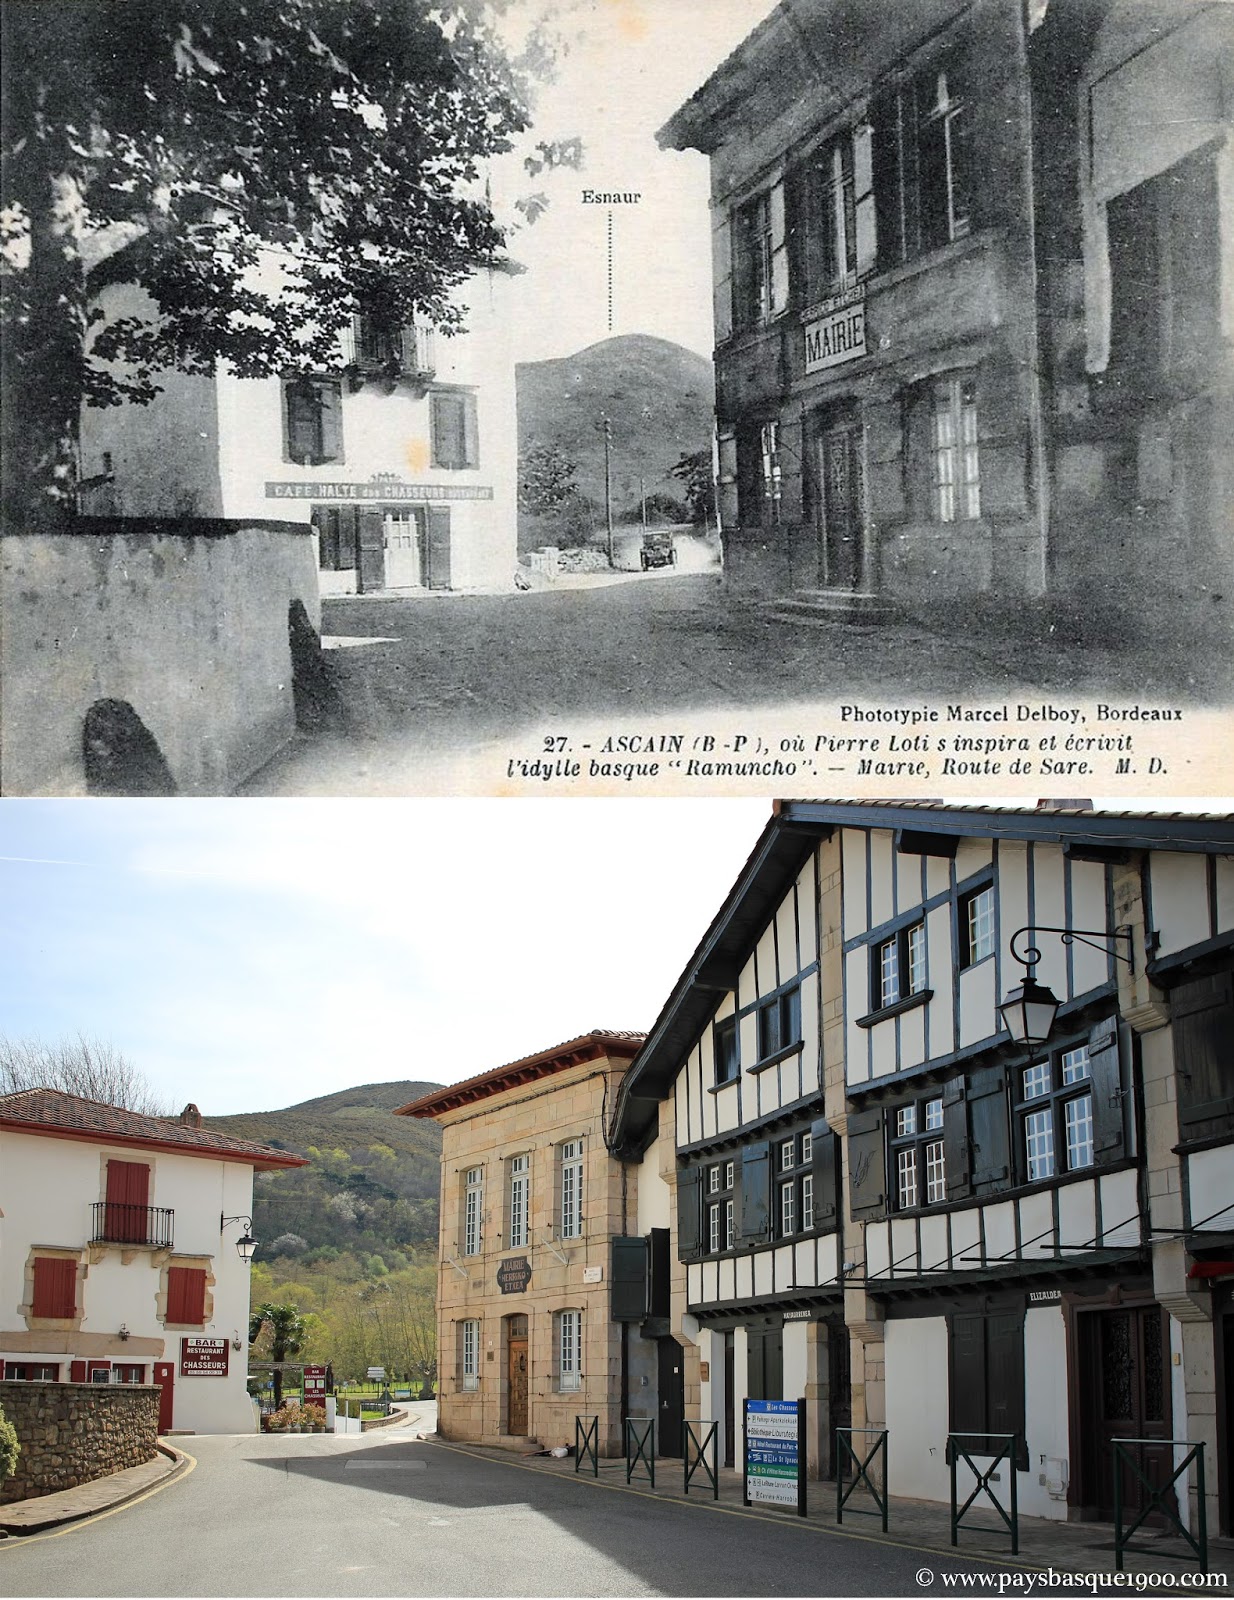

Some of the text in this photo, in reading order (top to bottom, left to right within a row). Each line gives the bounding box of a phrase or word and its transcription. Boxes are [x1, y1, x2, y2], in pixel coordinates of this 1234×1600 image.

[806, 314, 864, 363] MAIRIE
[319, 485, 357, 497] HALTE
[384, 487, 445, 498] CHASSEURS
[503, 1260, 525, 1271] MAIRIE
[501, 1271, 526, 1282] HERRIKO
[505, 1281, 524, 1291] ETXEA
[183, 1361, 226, 1369] CHASSEURS
[779, 1404, 798, 1412] Chasseur
